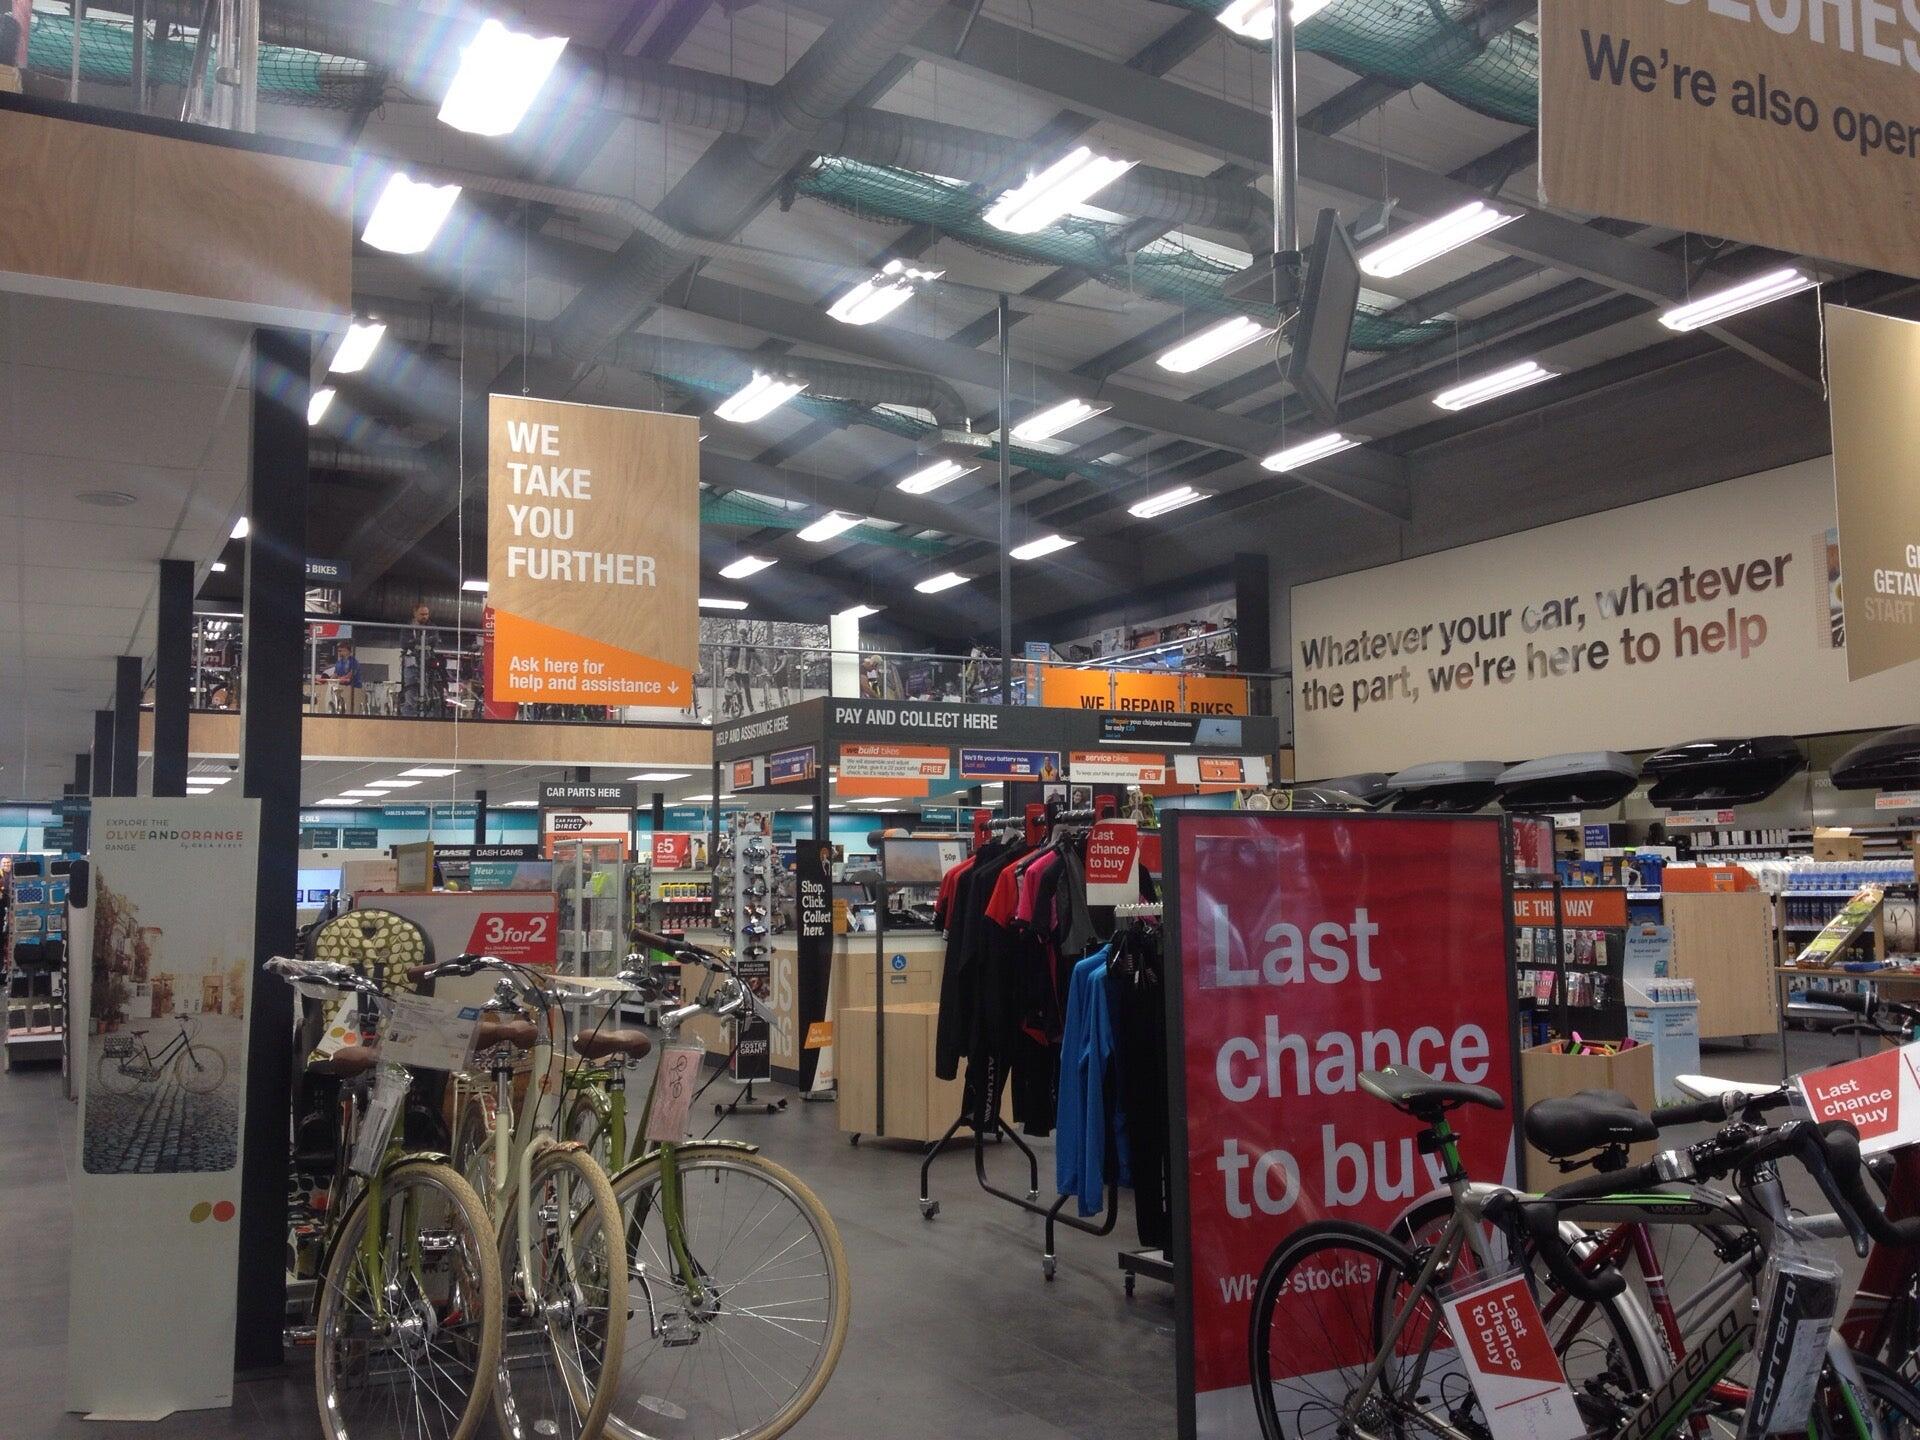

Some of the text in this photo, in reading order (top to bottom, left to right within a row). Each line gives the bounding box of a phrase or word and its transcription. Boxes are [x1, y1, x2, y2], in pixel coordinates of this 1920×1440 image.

[1731, 74, 1819, 132] also
[507, 420, 560, 456] WE
[507, 462, 591, 500] TAKE
[507, 504, 574, 540] YOU
[312, 565, 338, 575] BIKES
[507, 546, 656, 587] FURTHER
[1301, 552, 1793, 670] Whatever your car, whatever
[1864, 597, 1915, 624] START
[509, 655, 605, 675] Ask here for
[1301, 609, 1768, 713] the part, we're here to help
[509, 674, 661, 694] help and assistance
[1080, 695, 1233, 715] WE REPAIR BIKES
[836, 708, 998, 730] PAY AND COLLECT HERE
[1142, 719, 1162, 727] chipped
[716, 715, 789, 746] HELP AND ASSISTANCE HERE
[922, 765, 943, 773] FREE
[546, 787, 621, 798] CAR PARTS HERE
[106, 831, 244, 840] OLIVEANDORANGE
[657, 838, 674, 853] £5
[1092, 830, 1114, 840] Last
[1090, 844, 1130, 855] chance
[474, 867, 494, 875] New
[1090, 857, 1124, 871] to buy
[801, 880, 825, 895] Shop.
[801, 895, 826, 908] Click.
[1514, 900, 1594, 917] UE THI WAY
[803, 910, 831, 923] Collect
[803, 924, 825, 937] here.
[1214, 904, 1383, 988] Last
[1216, 1014, 1490, 1103] chance
[1816, 1079, 1860, 1100] Last
[1824, 1088, 1893, 1116] chance
[1851, 1107, 1888, 1126] buy
[1217, 1138, 1300, 1220] to
[1293, 1260, 1372, 1293] stocks
[1472, 1305, 1486, 1327] to
[1502, 1294, 1528, 1339] Last
[1487, 1301, 1522, 1371] chance
[1481, 1329, 1503, 1365] buy
